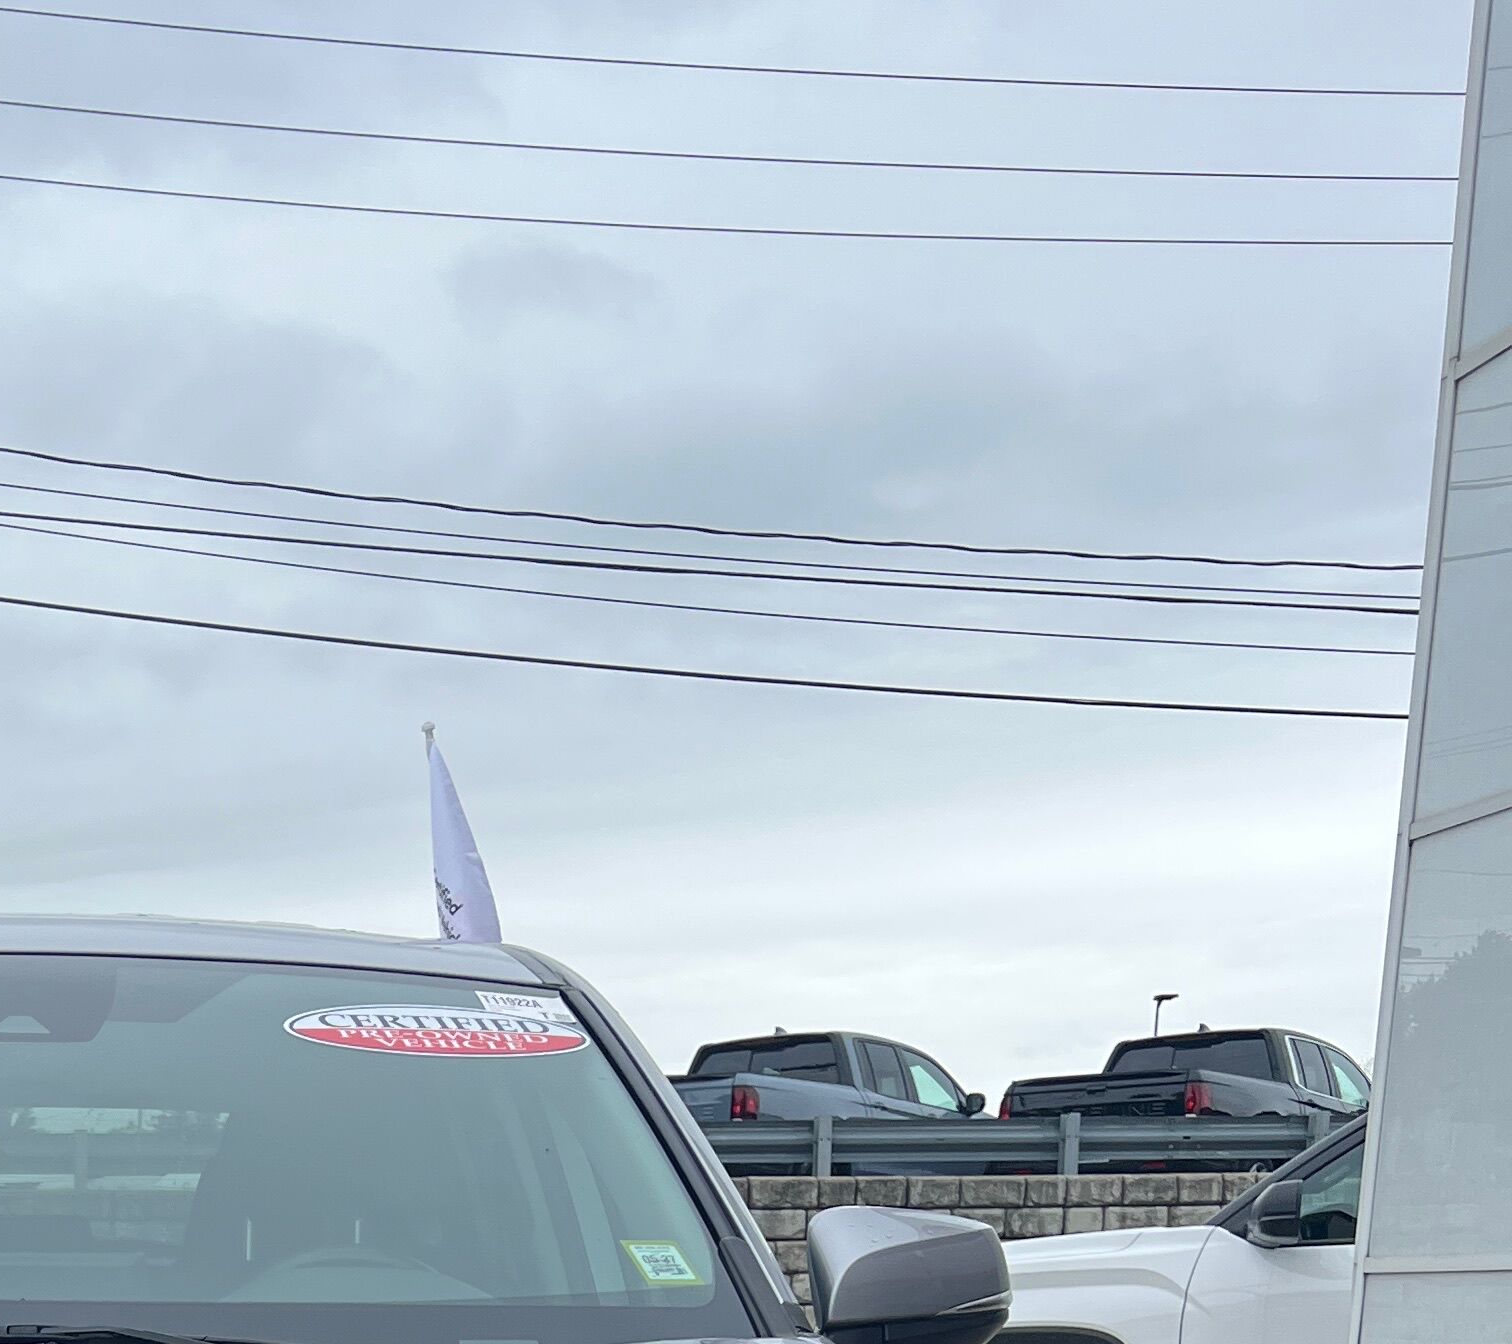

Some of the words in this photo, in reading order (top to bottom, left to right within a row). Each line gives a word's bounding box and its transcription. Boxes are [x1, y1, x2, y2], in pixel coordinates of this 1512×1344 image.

[318, 1013, 550, 1034] CERTIFIED
[338, 1028, 549, 1044] PRE-OWNED
[374, 1037, 528, 1051] VEHICLE
